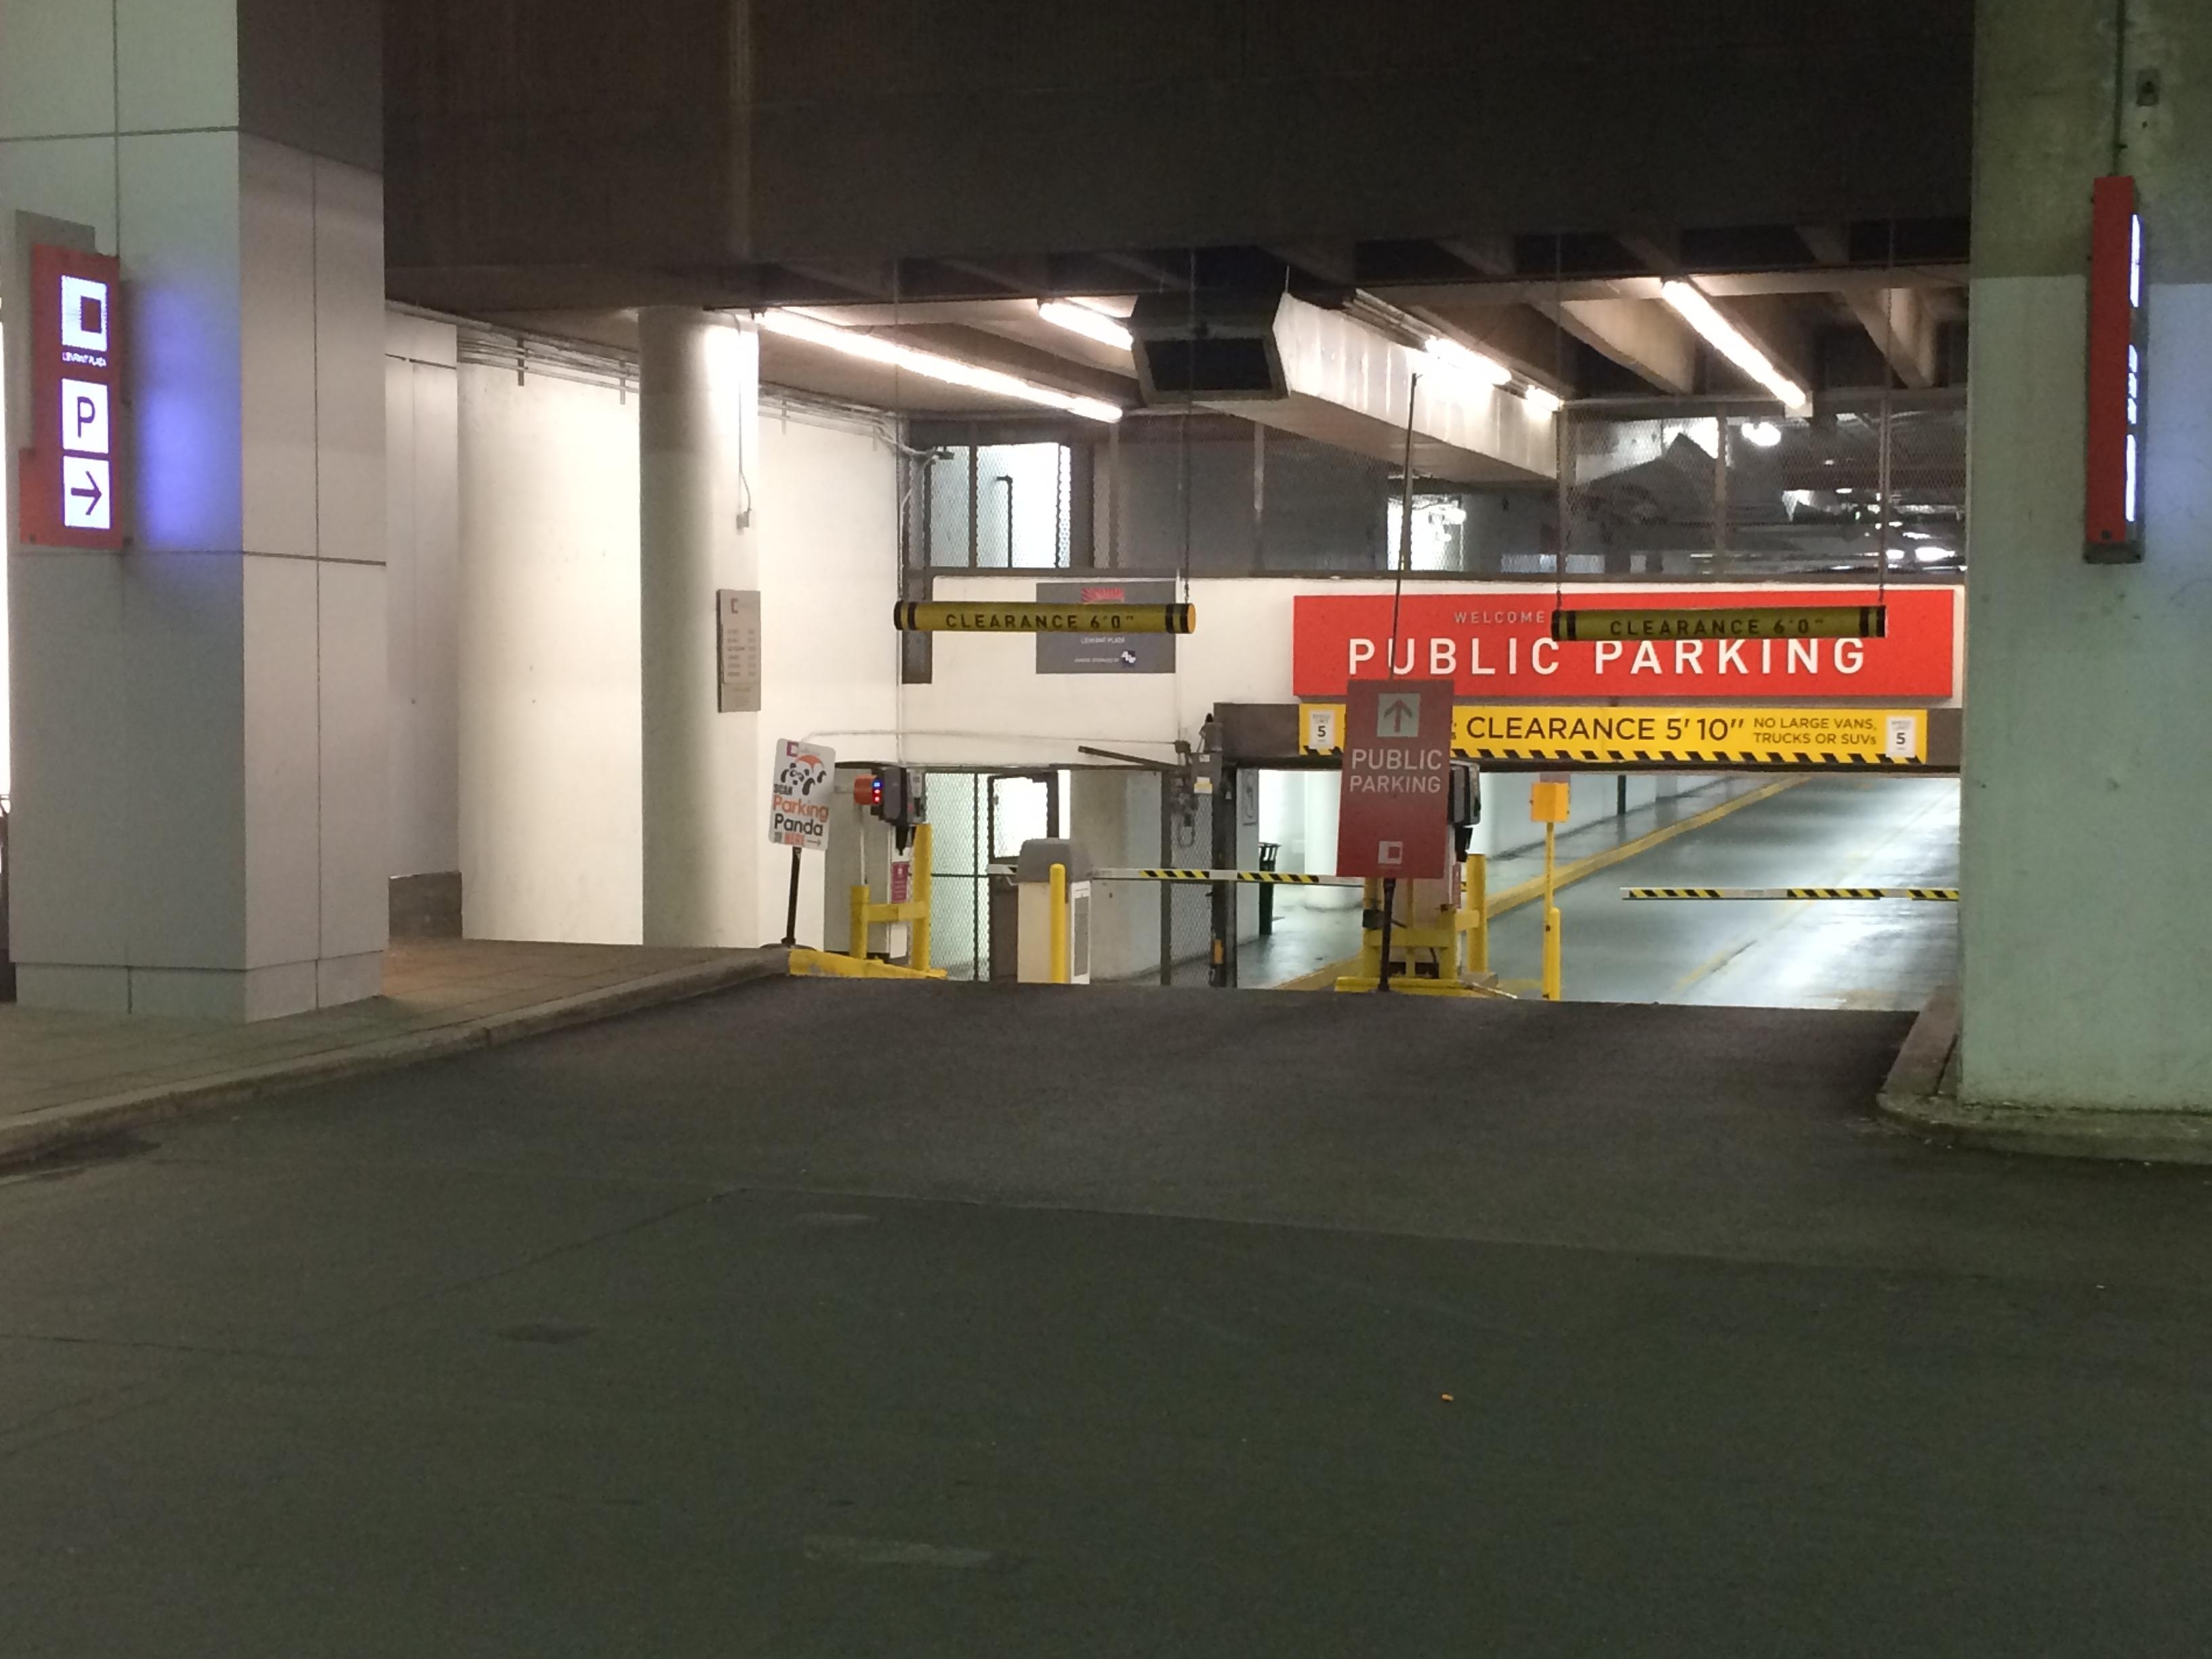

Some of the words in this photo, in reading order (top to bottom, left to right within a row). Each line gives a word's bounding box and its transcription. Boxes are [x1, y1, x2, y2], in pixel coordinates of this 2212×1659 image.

[77, 396, 96, 438] P
[945, 614, 1078, 629] CLEARANCE
[1454, 611, 1545, 623] WELCOME
[1610, 619, 1760, 636] CLEARANCE
[1349, 637, 1559, 675] PUBLIC
[1595, 638, 1864, 675] PARKING
[1317, 725, 1326, 737] 5
[1466, 716, 1655, 741] CLEARANCE
[1754, 717, 1776, 729] NO
[1780, 717, 1830, 729] LARGE
[1834, 718, 1877, 731] VANS,
[1753, 732, 1811, 745] TRUCKS
[1815, 733, 1837, 744] OR
[1841, 733, 1877, 745] SUVs
[1896, 733, 1906, 745] 5
[1351, 748, 1443, 770] PUBLIC
[1349, 775, 1441, 794] PARKING
[773, 794, 830, 823] Parking
[774, 813, 823, 836] Panda
